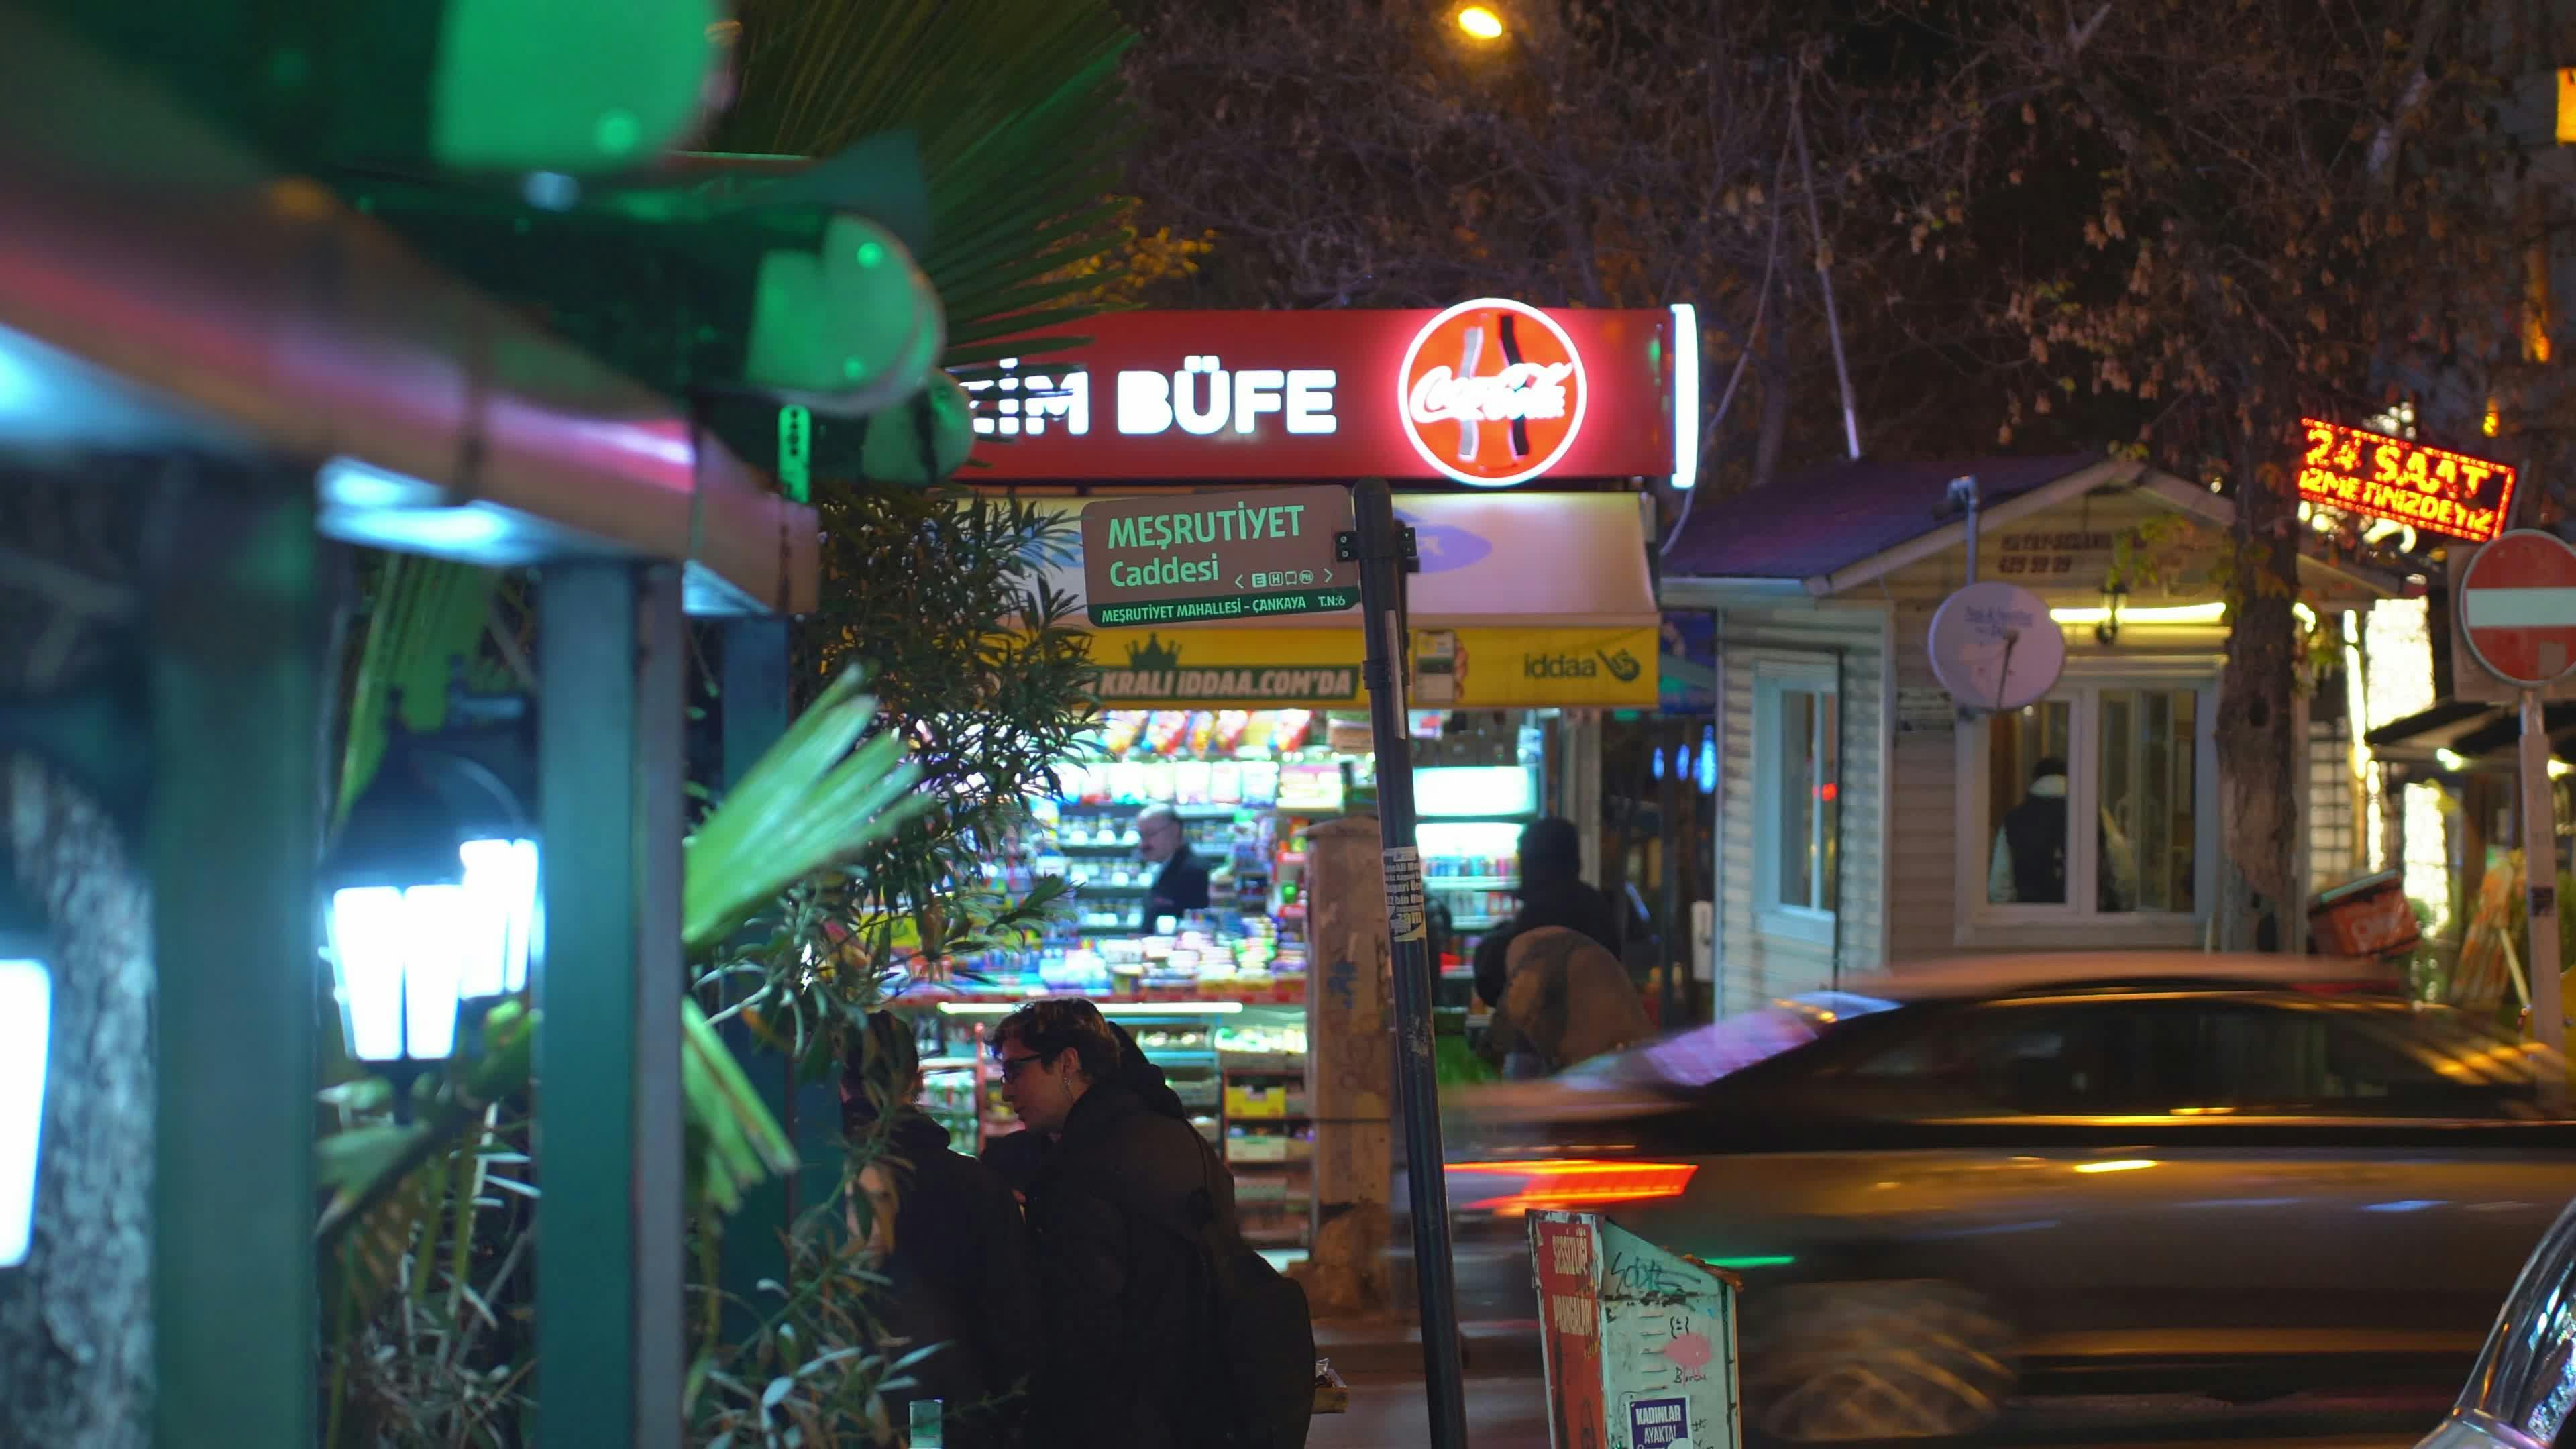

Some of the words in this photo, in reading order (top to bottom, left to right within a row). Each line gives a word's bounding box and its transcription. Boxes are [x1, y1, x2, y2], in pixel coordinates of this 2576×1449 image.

[1118, 355, 1337, 435] BÜFE
[2373, 443, 2492, 500] SAAT
[1108, 500, 1305, 550] MEŞRUTİYET
[1110, 553, 1220, 587] Caddesi
[1102, 604, 1174, 624] MEŞRUTİYET
[1177, 598, 1242, 618] MAHALLESİ
[1252, 596, 1307, 613] ÇANKAYA
[1635, 1404, 1682, 1426] KADINLAR
